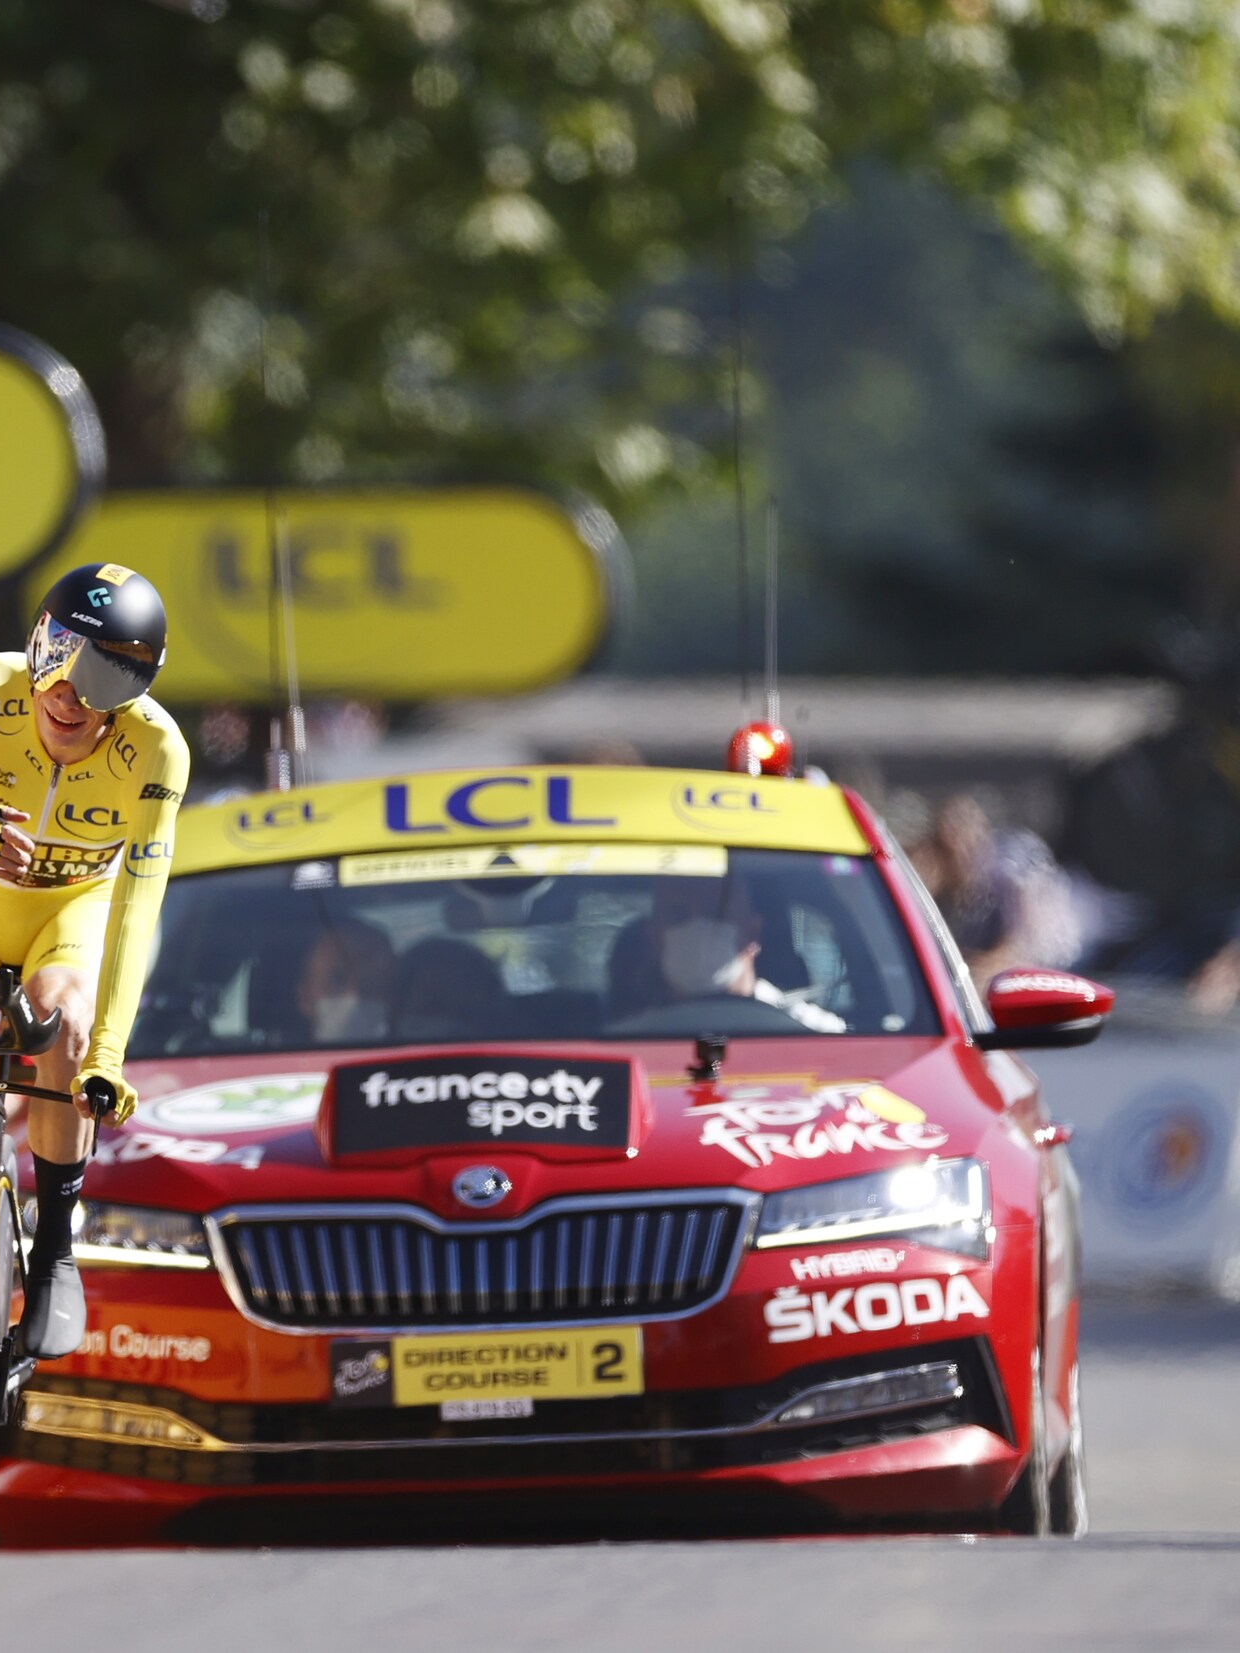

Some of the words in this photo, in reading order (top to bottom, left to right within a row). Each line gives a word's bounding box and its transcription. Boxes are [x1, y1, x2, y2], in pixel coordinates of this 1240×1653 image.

[71, 611, 104, 628] LAZER
[24, 748, 44, 777] LCL
[114, 733, 138, 773] LCL
[66, 770, 95, 783] LCL
[64, 803, 128, 827] LCL
[383, 775, 618, 833] LCL
[683, 786, 780, 813] LCL
[239, 801, 333, 832] LCL
[466, 1100, 599, 1136] sport
[789, 1247, 900, 1281] HYBRID
[763, 1273, 991, 1344] ŠKODA
[110, 1323, 211, 1363] Course
[402, 1342, 569, 1368] DIRECTION
[591, 1341, 627, 1384] 2
[423, 1366, 551, 1392] COURSE
